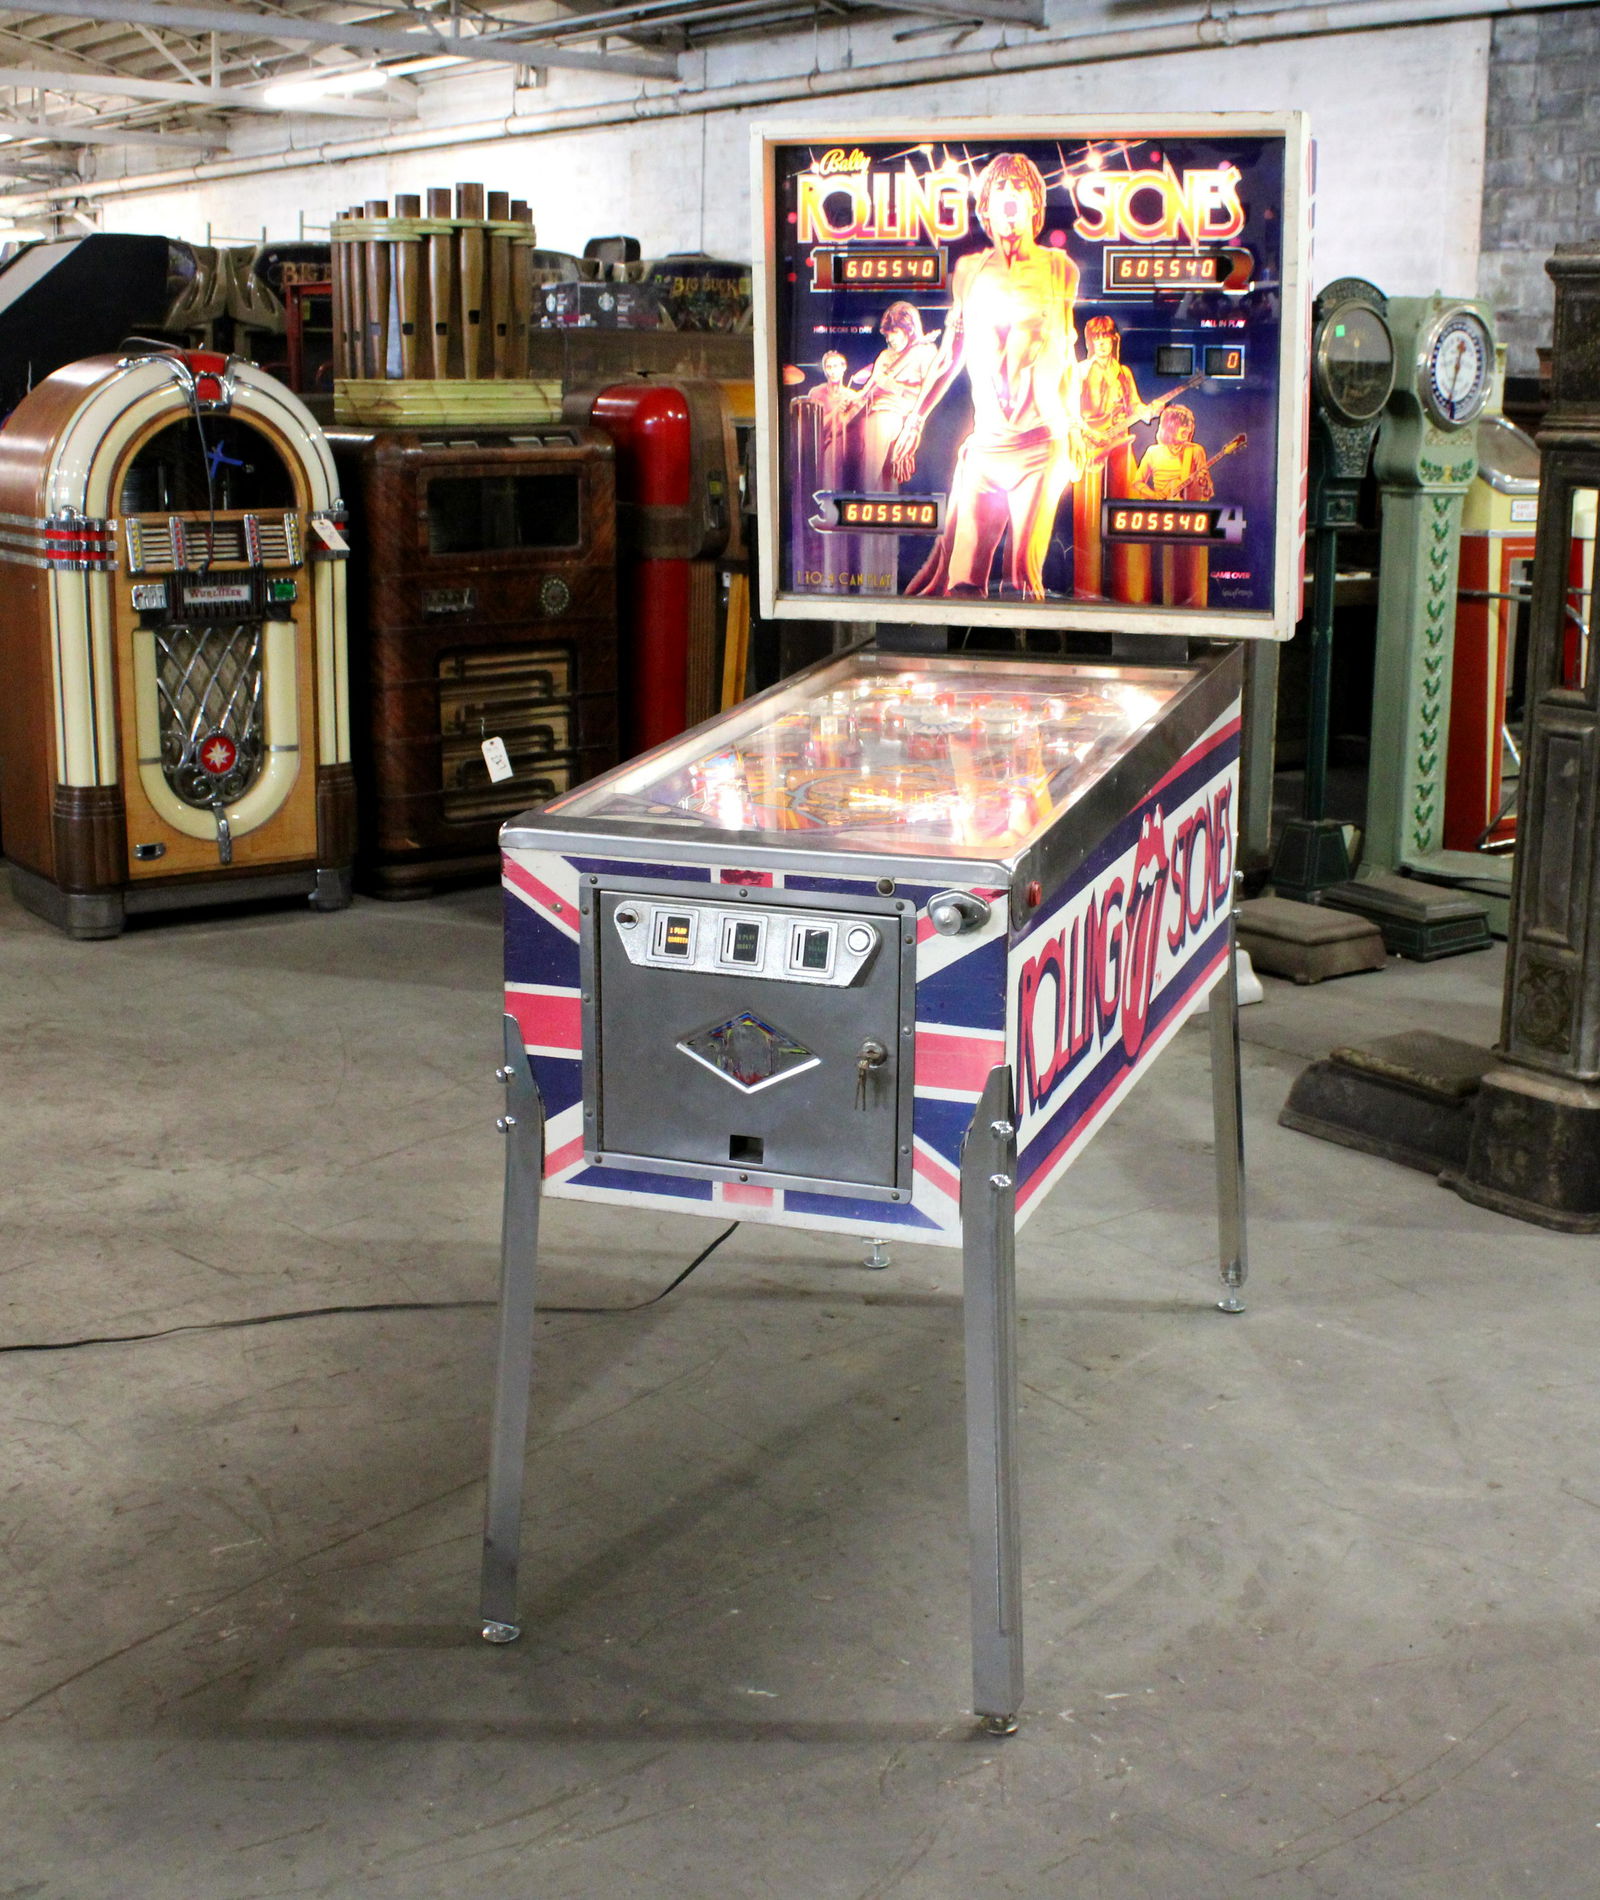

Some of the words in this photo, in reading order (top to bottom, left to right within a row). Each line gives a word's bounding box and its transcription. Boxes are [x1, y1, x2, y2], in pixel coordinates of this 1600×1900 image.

[819, 148, 871, 176] Bally
[797, 158, 969, 249] ROLLING
[1073, 153, 1245, 252] STONES
[846, 260, 934, 278] 605540
[1120, 259, 1214, 278] 605540
[1226, 351, 1240, 369] 0
[847, 504, 933, 523] 605540
[1115, 511, 1208, 532] 605540
[1017, 875, 1124, 1118] ROLLING
[1166, 776, 1233, 956] STONES
